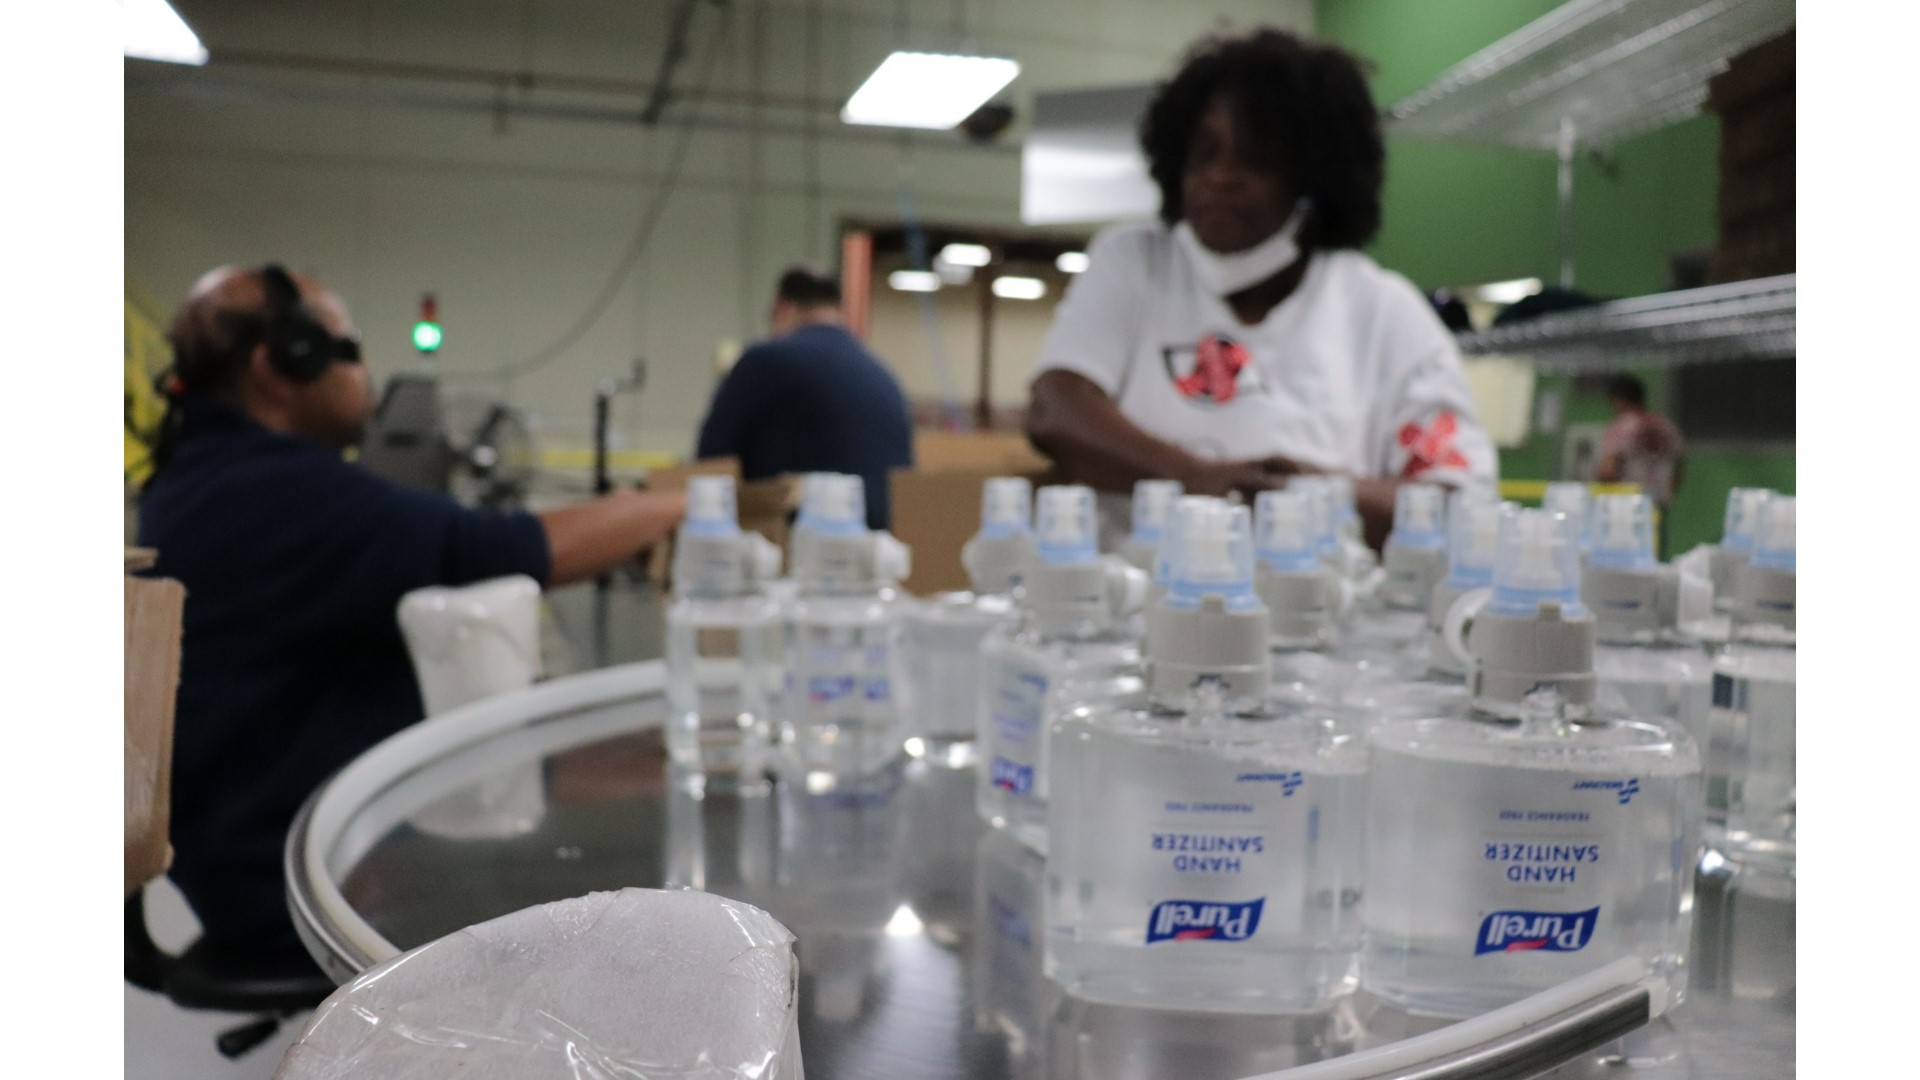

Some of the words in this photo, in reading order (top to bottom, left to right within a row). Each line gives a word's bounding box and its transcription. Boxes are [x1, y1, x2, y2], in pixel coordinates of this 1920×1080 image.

[1152, 834, 1264, 853] SANITIZER
[1485, 843, 1600, 862] SANITIZER
[1173, 855, 1241, 872] HAND
[1507, 865, 1576, 882] HAND
[1154, 904, 1252, 939] Purell
[1485, 914, 1585, 950] Purell
